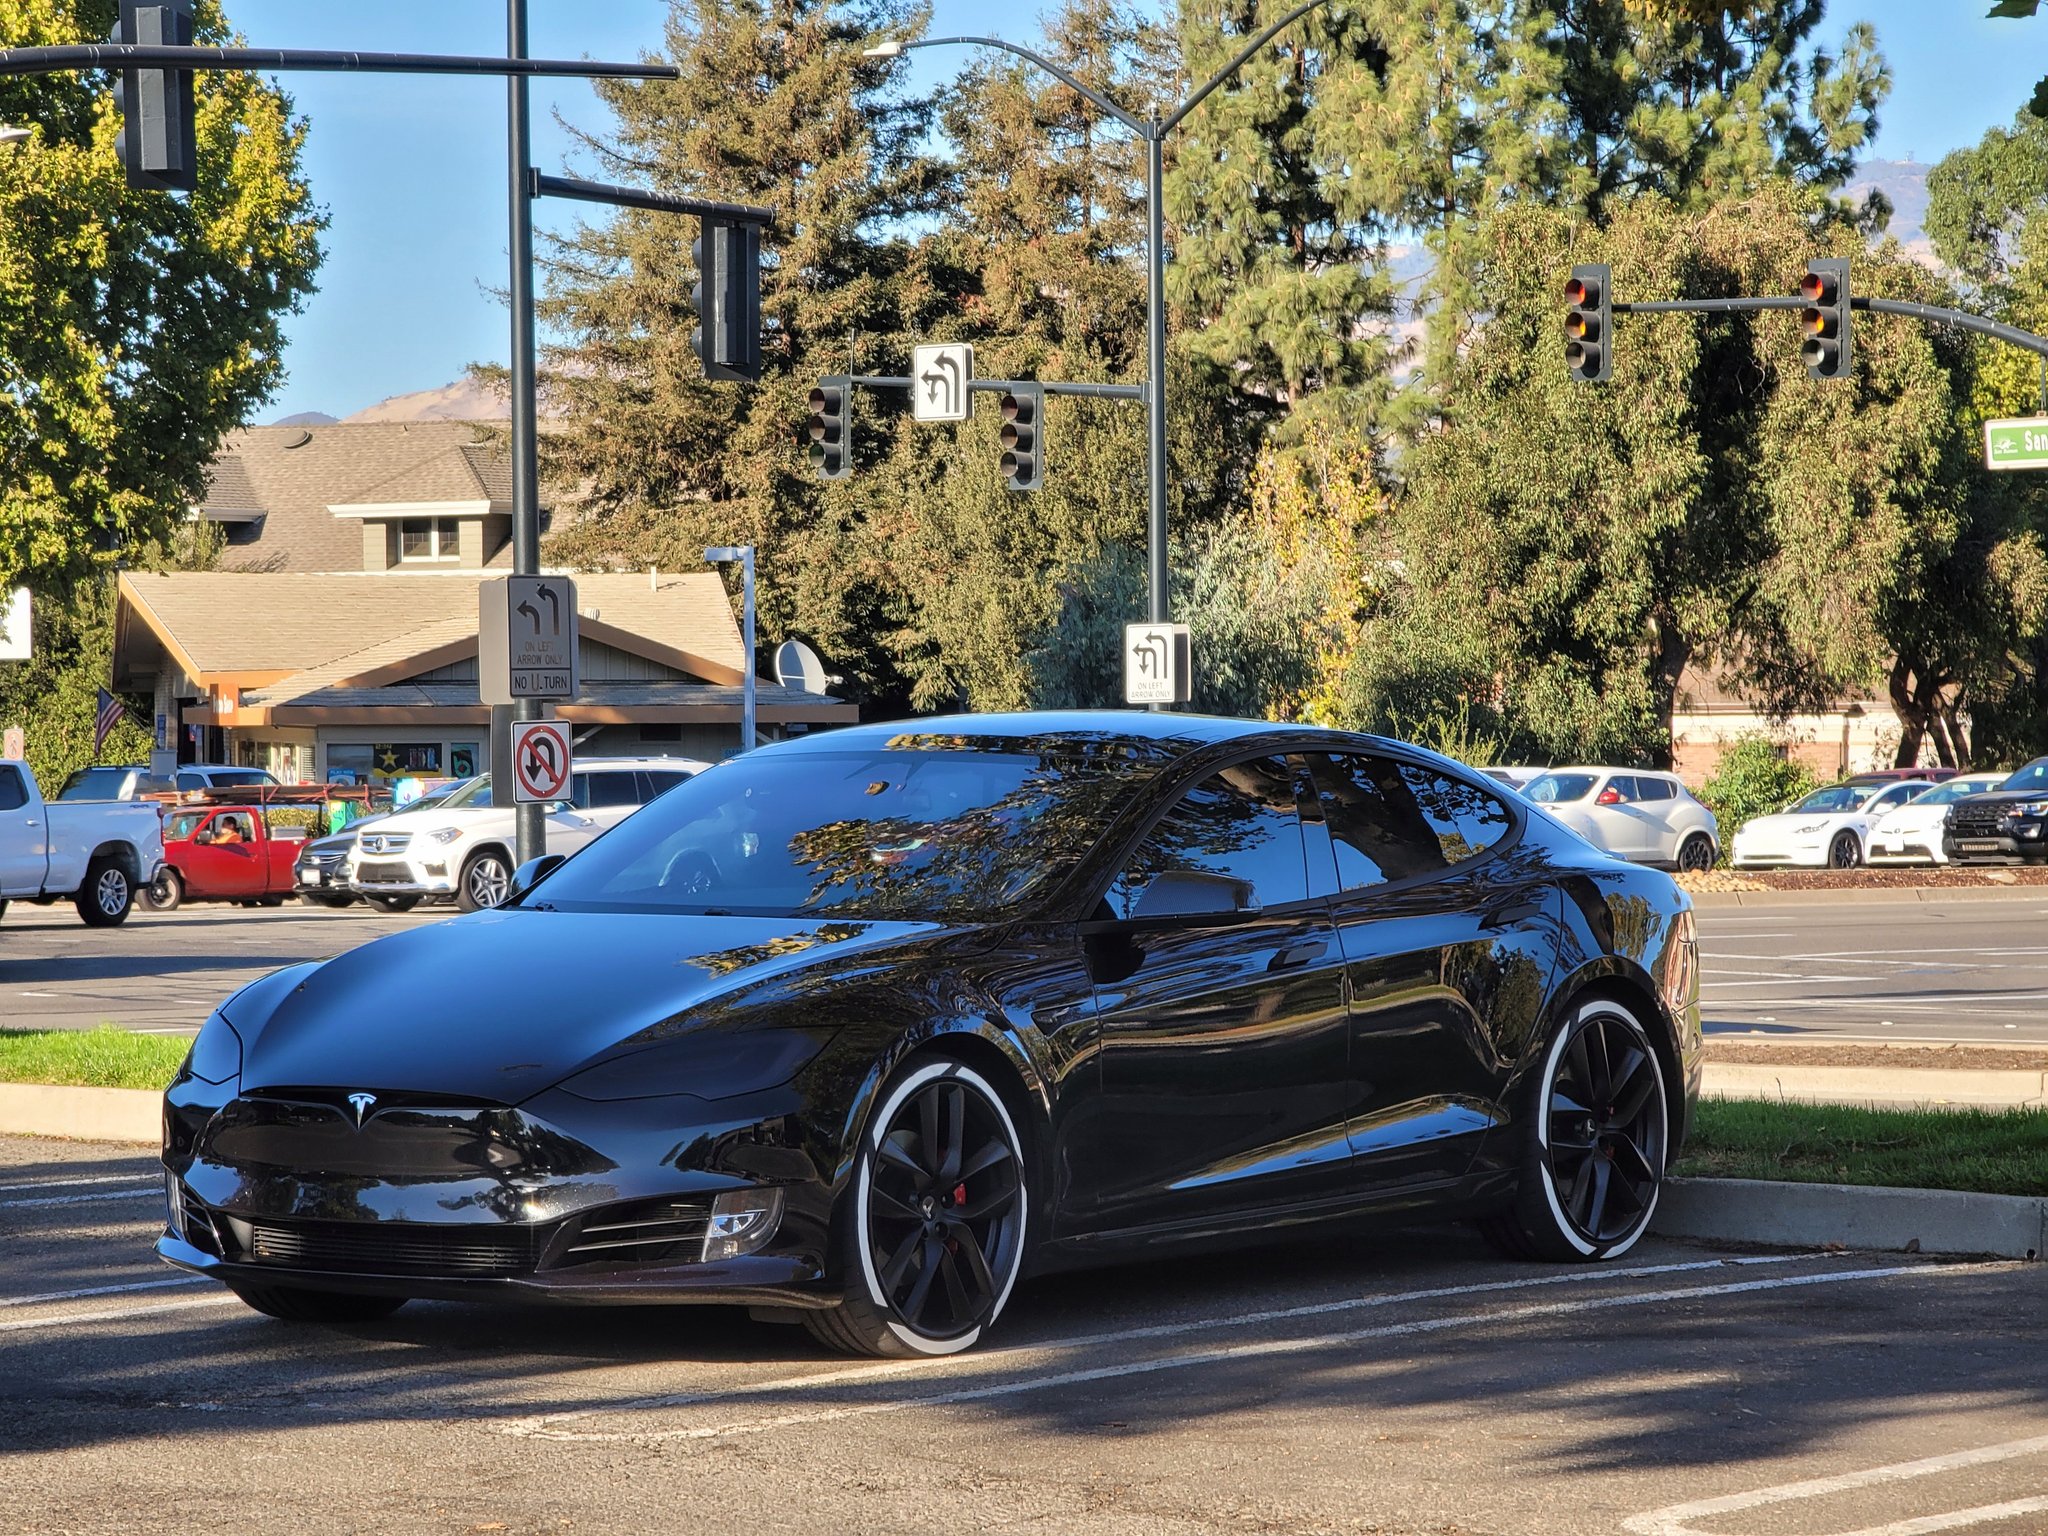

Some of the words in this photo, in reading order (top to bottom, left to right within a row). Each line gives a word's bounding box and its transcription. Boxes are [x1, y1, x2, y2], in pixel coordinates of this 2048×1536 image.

[2024, 430, 2048, 452] San
[525, 640, 535, 652] ON
[537, 640, 553, 652] LEFT
[517, 654, 542, 665] ARROW
[545, 654, 563, 665] ONLY
[514, 676, 527, 689] NO
[544, 675, 568, 689] TURN
[1138, 682, 1147, 690] ON
[1148, 682, 1163, 690] LEFT
[1131, 690, 1153, 698] ARROW
[1155, 690, 1171, 698] ONLY
